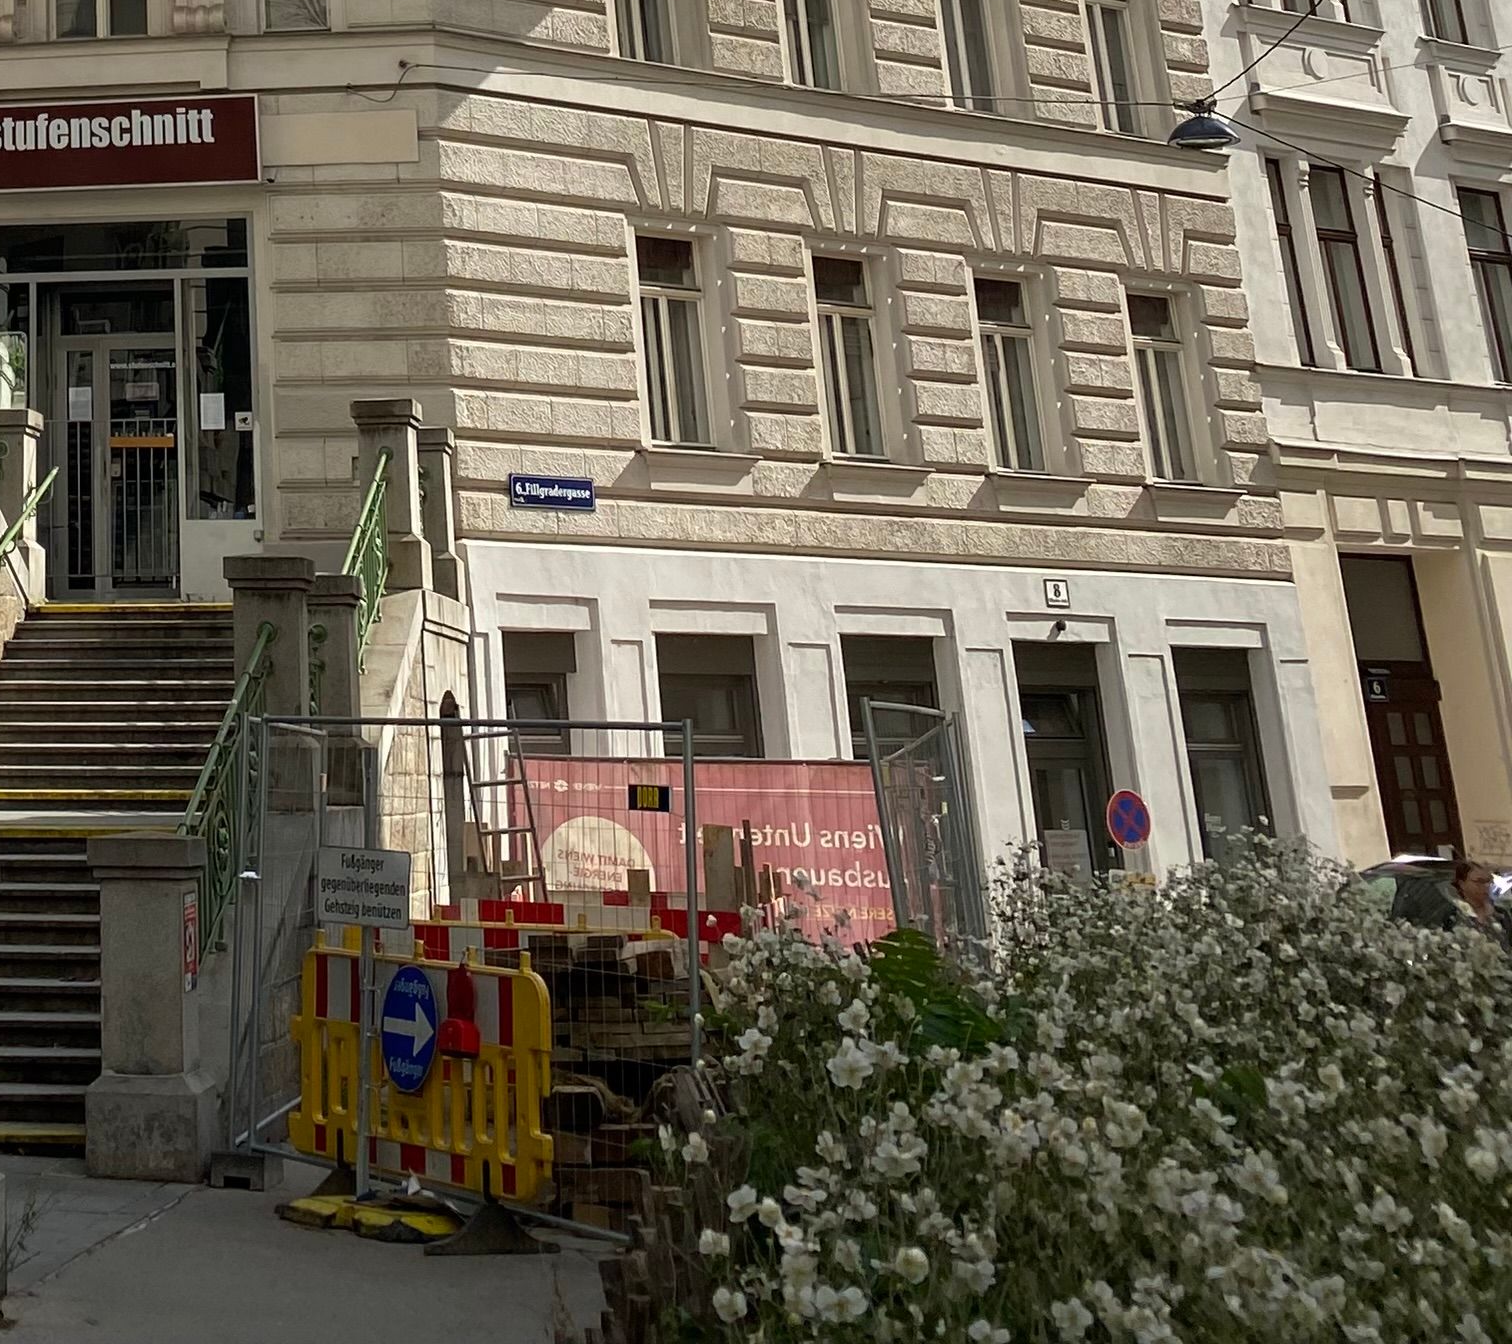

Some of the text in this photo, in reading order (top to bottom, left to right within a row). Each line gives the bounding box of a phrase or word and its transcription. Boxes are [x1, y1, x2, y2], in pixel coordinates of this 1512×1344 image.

[525, 482, 591, 501] Fillgradergasse
[1052, 583, 1061, 598] 8
[1372, 680, 1381, 695] 6
[341, 853, 384, 874] Fußgänger
[320, 877, 406, 897] gegenüberliegenden
[324, 897, 402, 921] Gehsteig benützen
